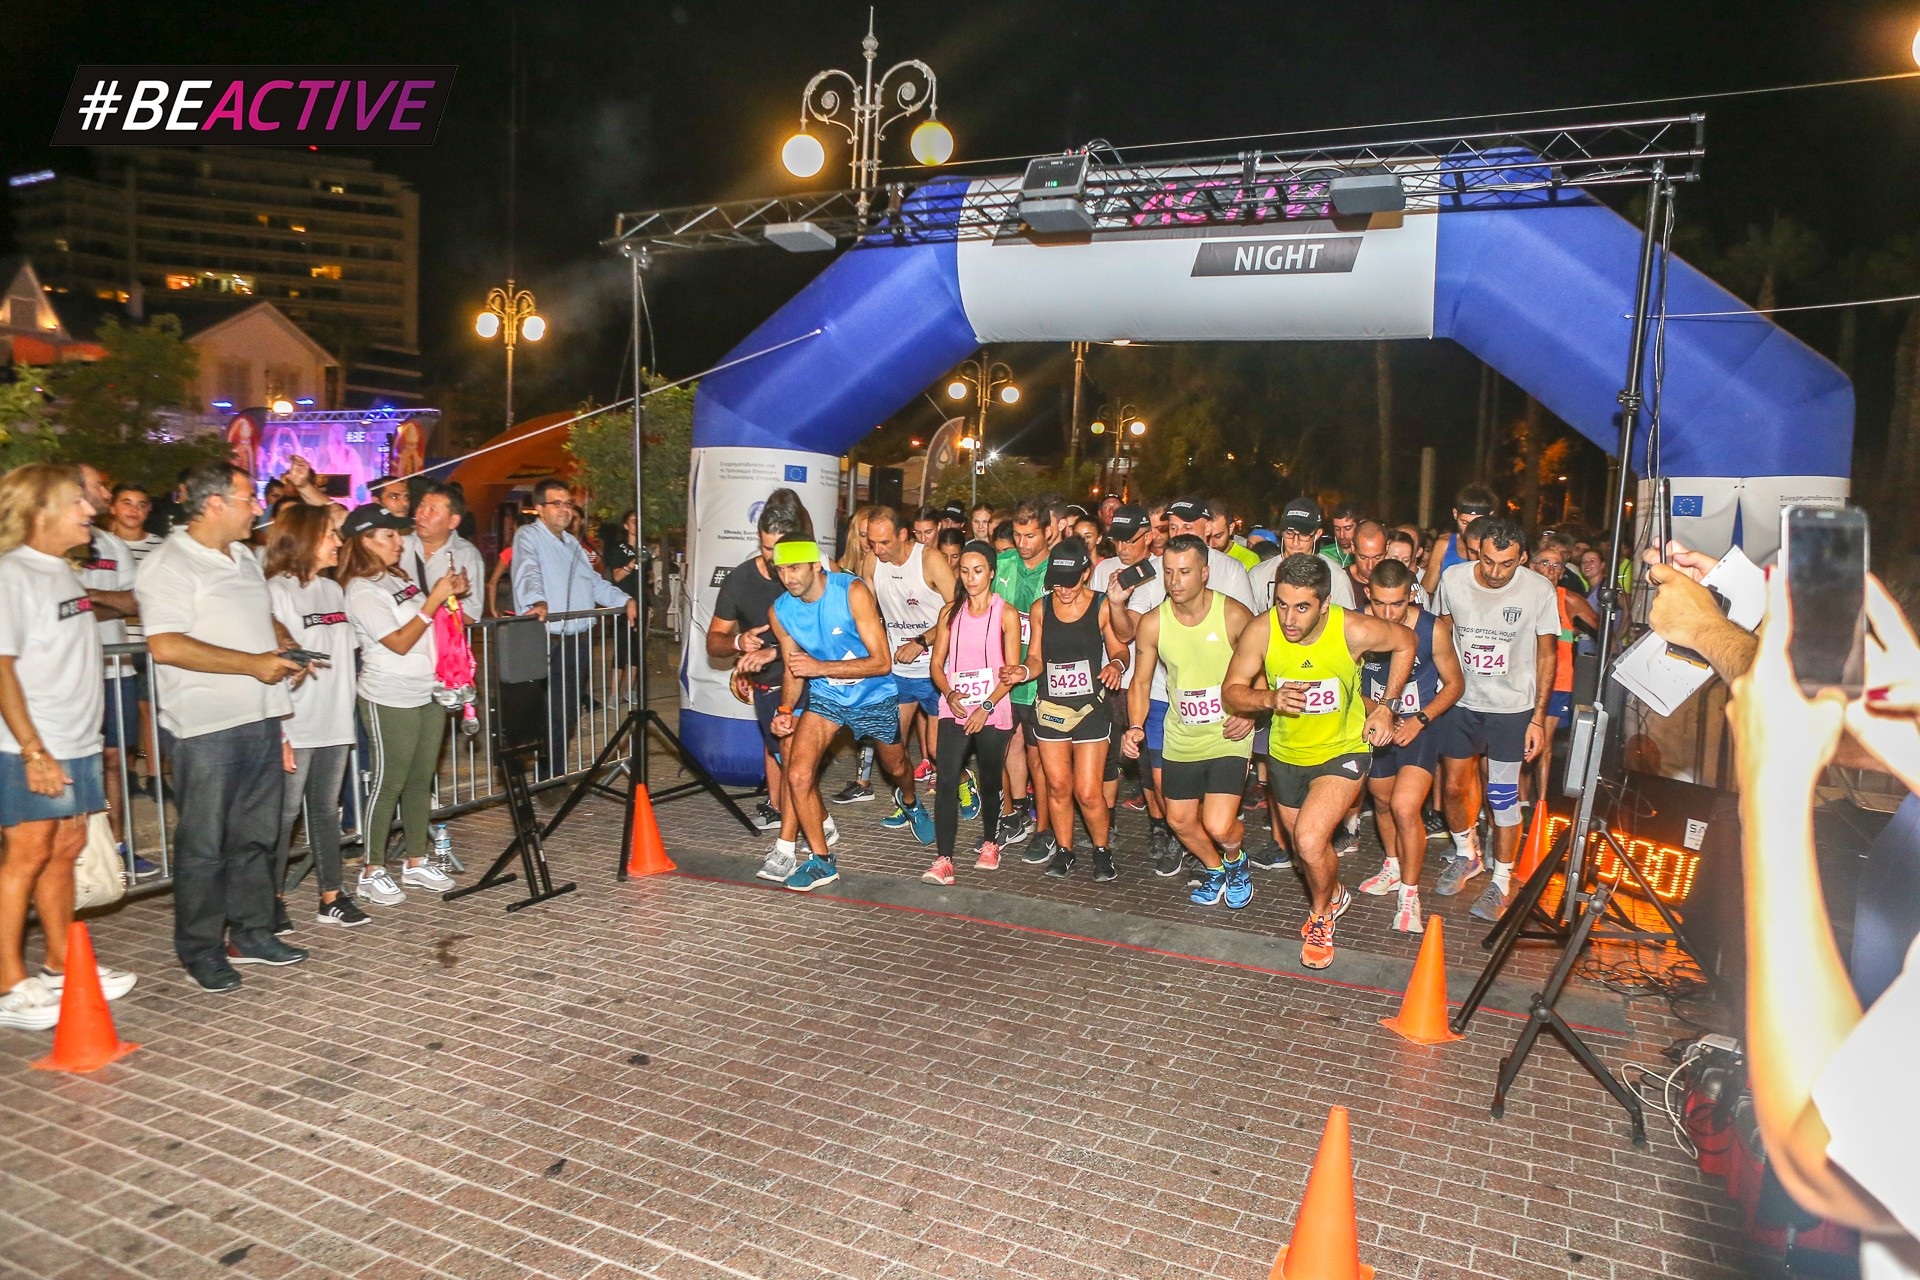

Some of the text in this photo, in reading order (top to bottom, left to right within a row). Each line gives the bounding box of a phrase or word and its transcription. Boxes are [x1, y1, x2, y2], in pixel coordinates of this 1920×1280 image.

[1233, 243, 1325, 272] NIGHT
[1463, 651, 1505, 669] 5124
[1050, 672, 1088, 689] 5428
[1180, 698, 1221, 717] 5085
[1303, 690, 1335, 707] 28
